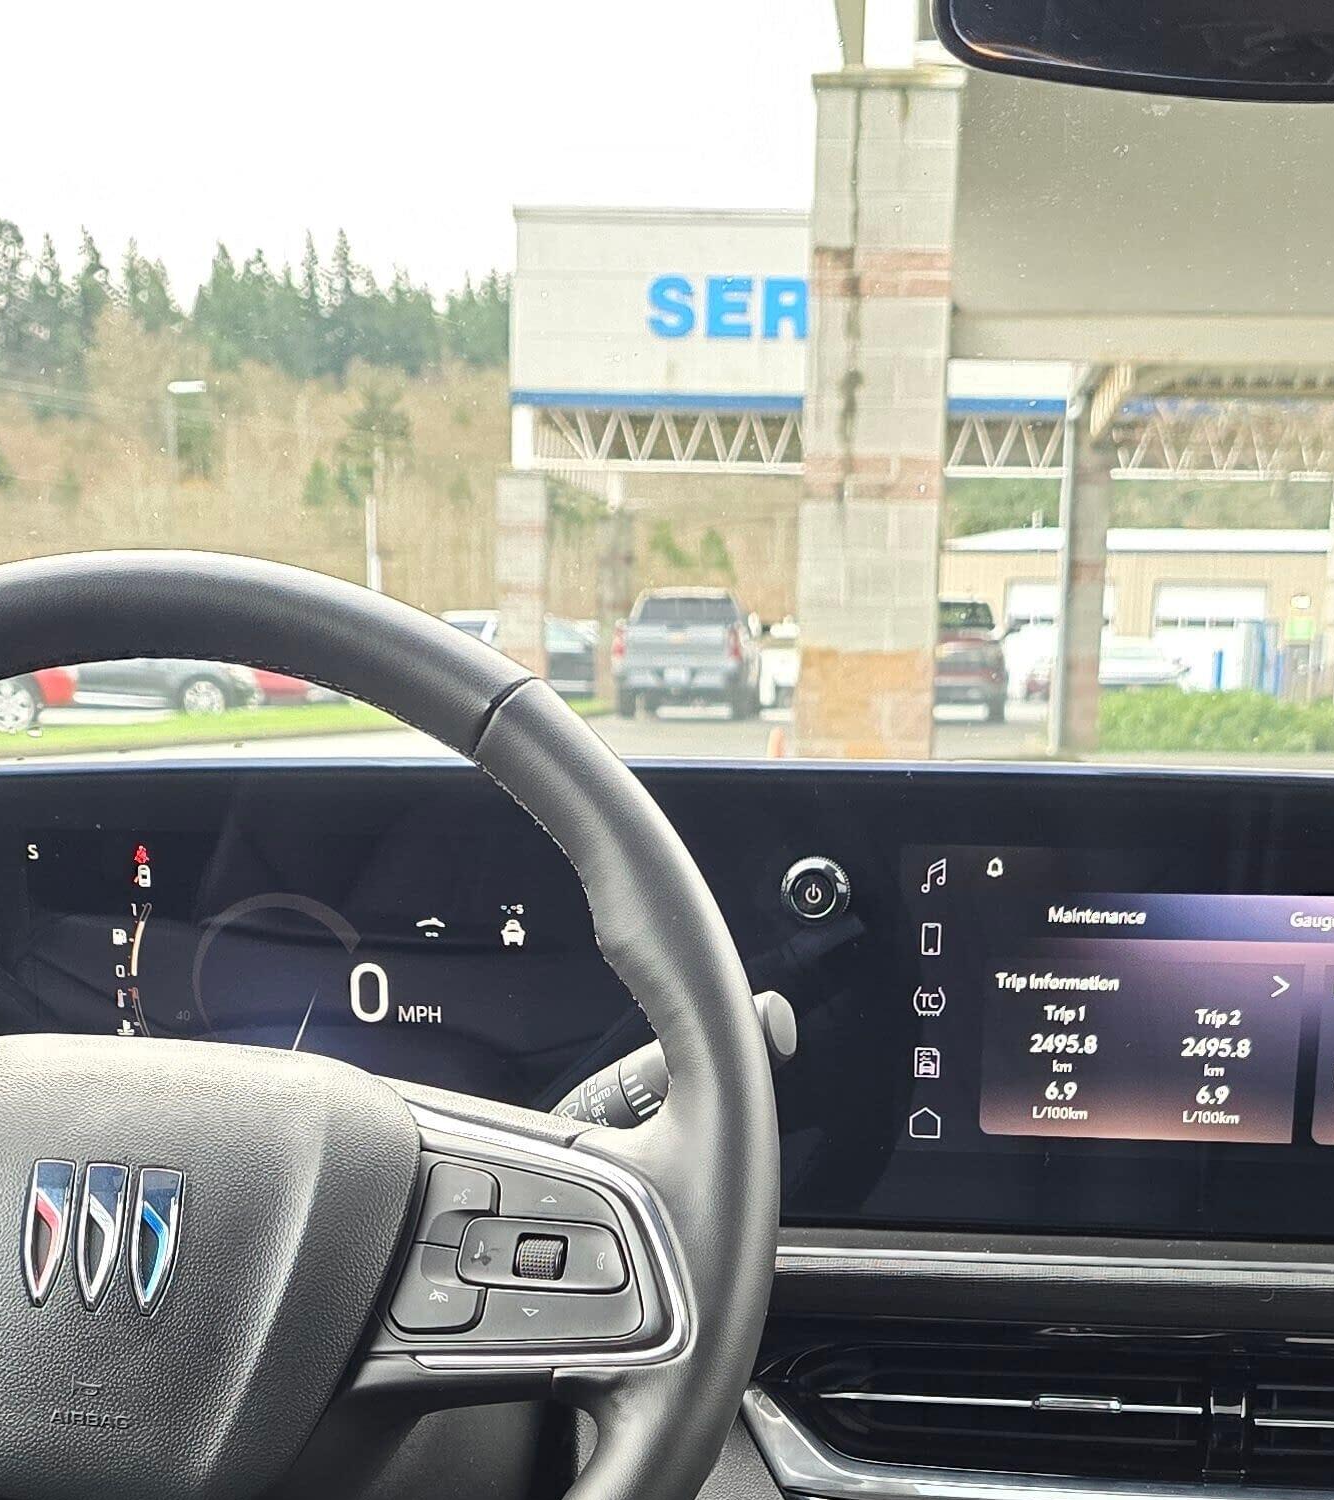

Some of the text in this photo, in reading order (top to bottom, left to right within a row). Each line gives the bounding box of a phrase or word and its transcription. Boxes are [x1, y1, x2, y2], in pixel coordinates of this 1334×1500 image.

[647, 275, 807, 338] SER
[1047, 906, 1147, 925] Maintenance
[995, 972, 1120, 993] Trip Information
[350, 962, 442, 1024] 0 MPH
[919, 993, 940, 1009] TC
[1043, 1004, 1086, 1026] Trip 1
[1194, 1008, 1242, 1029] Trip 2
[1029, 1033, 1098, 1055] 2495.8
[1180, 1037, 1251, 1059] 2495.8
[1052, 1059, 1073, 1073] km
[1203, 1063, 1225, 1077] km
[590, 1086, 612, 1107] AUTO
[1044, 1080, 1078, 1101] 6.9
[1195, 1085, 1230, 1105] 6.9
[590, 1101, 607, 1118] OFF
[1032, 1106, 1088, 1120] L/100km
[1182, 1110, 1240, 1124] L/100km
[49, 1409, 129, 1429] AIRBAG
